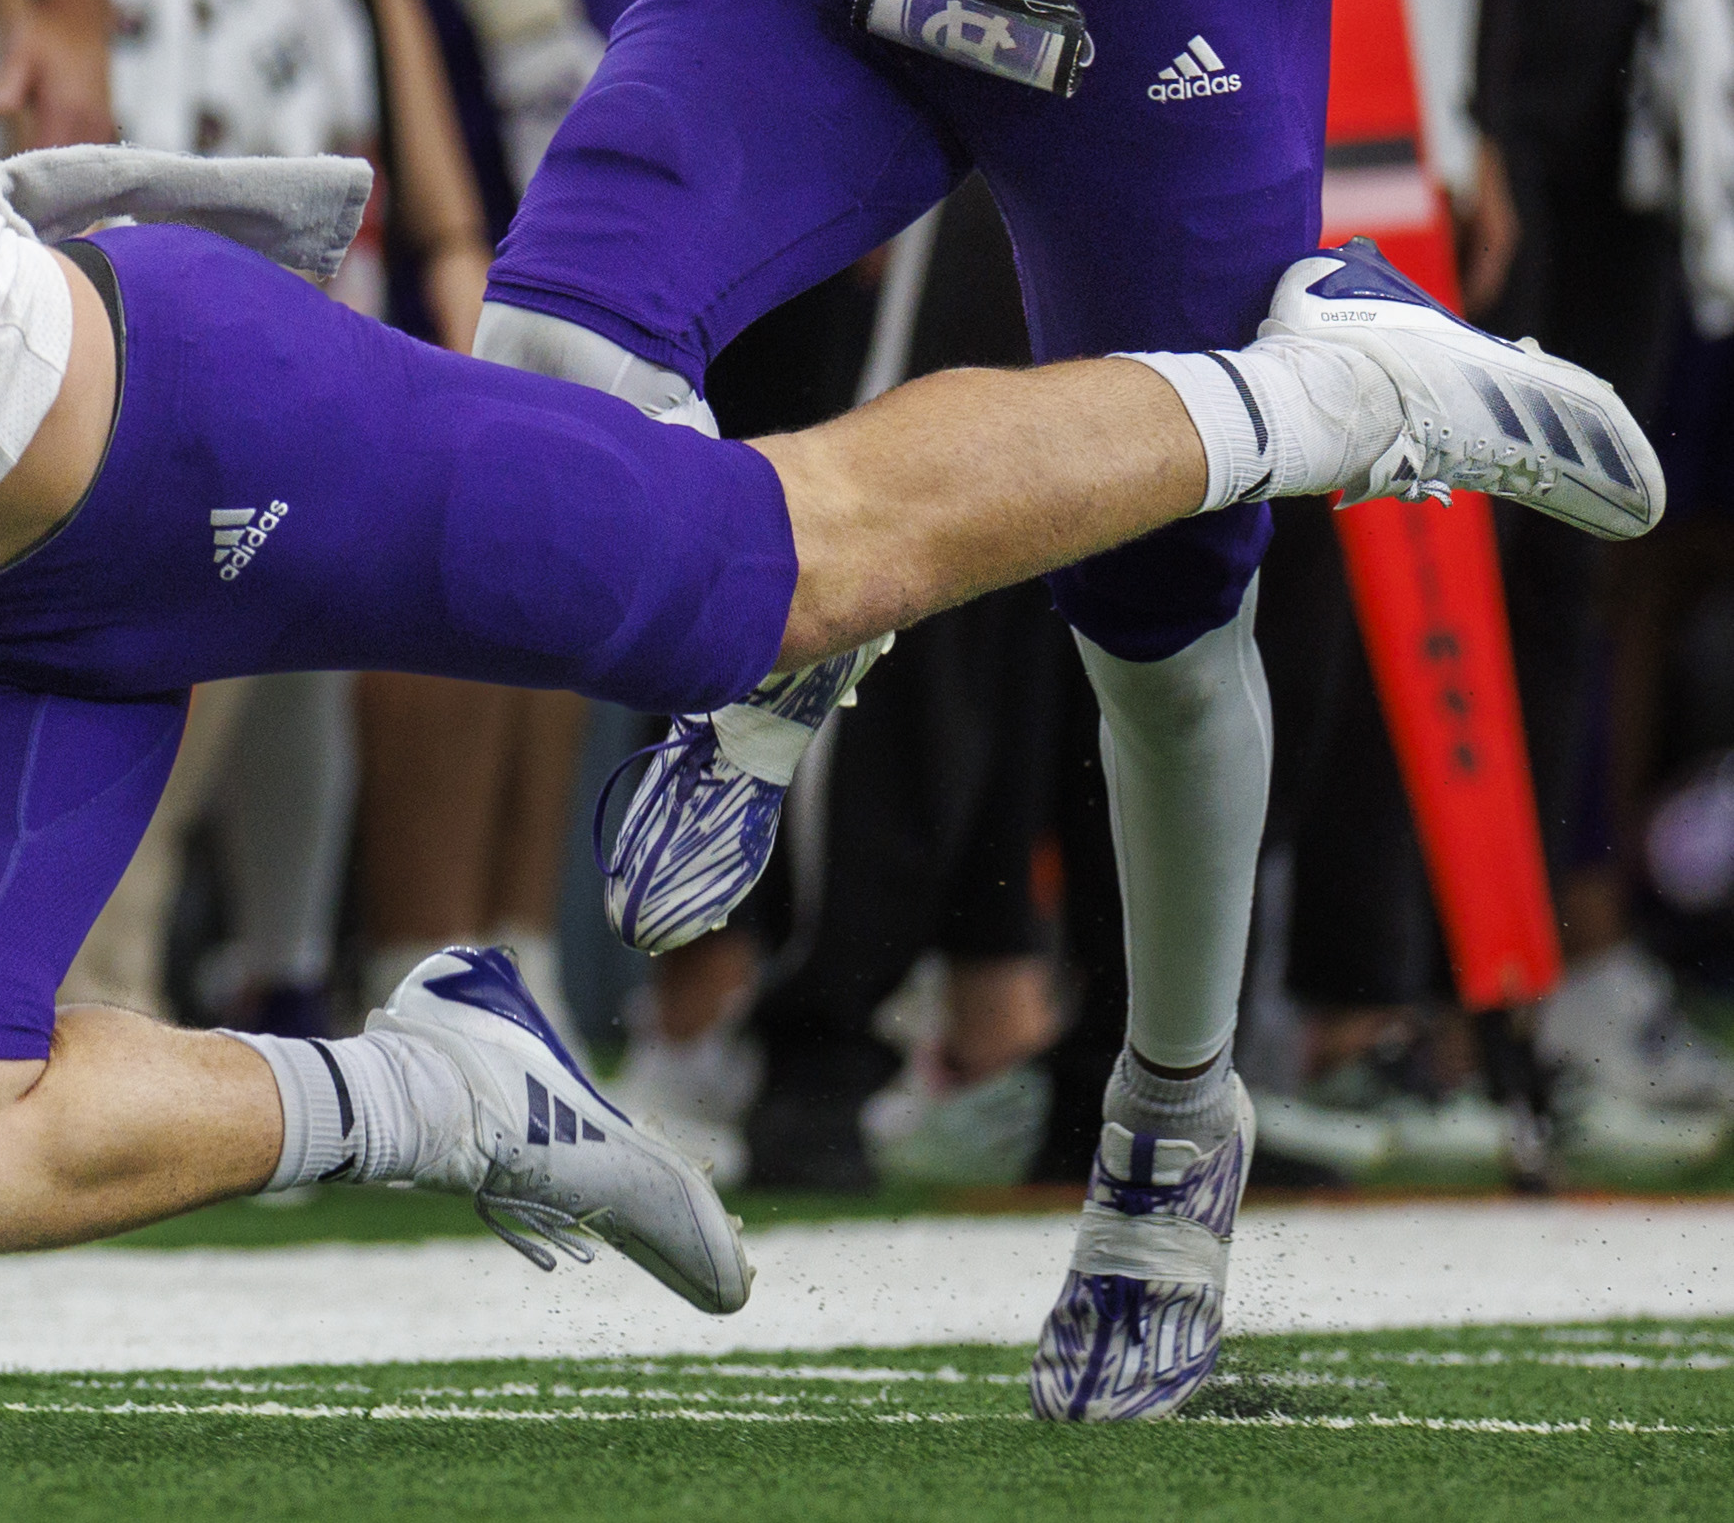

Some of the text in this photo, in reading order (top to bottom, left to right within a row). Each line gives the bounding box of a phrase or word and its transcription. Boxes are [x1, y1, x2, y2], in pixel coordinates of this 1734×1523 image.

[1147, 72, 1243, 103] adidas
[1320, 311, 1377, 322] ADIZERO
[219, 499, 289, 581] adidas
